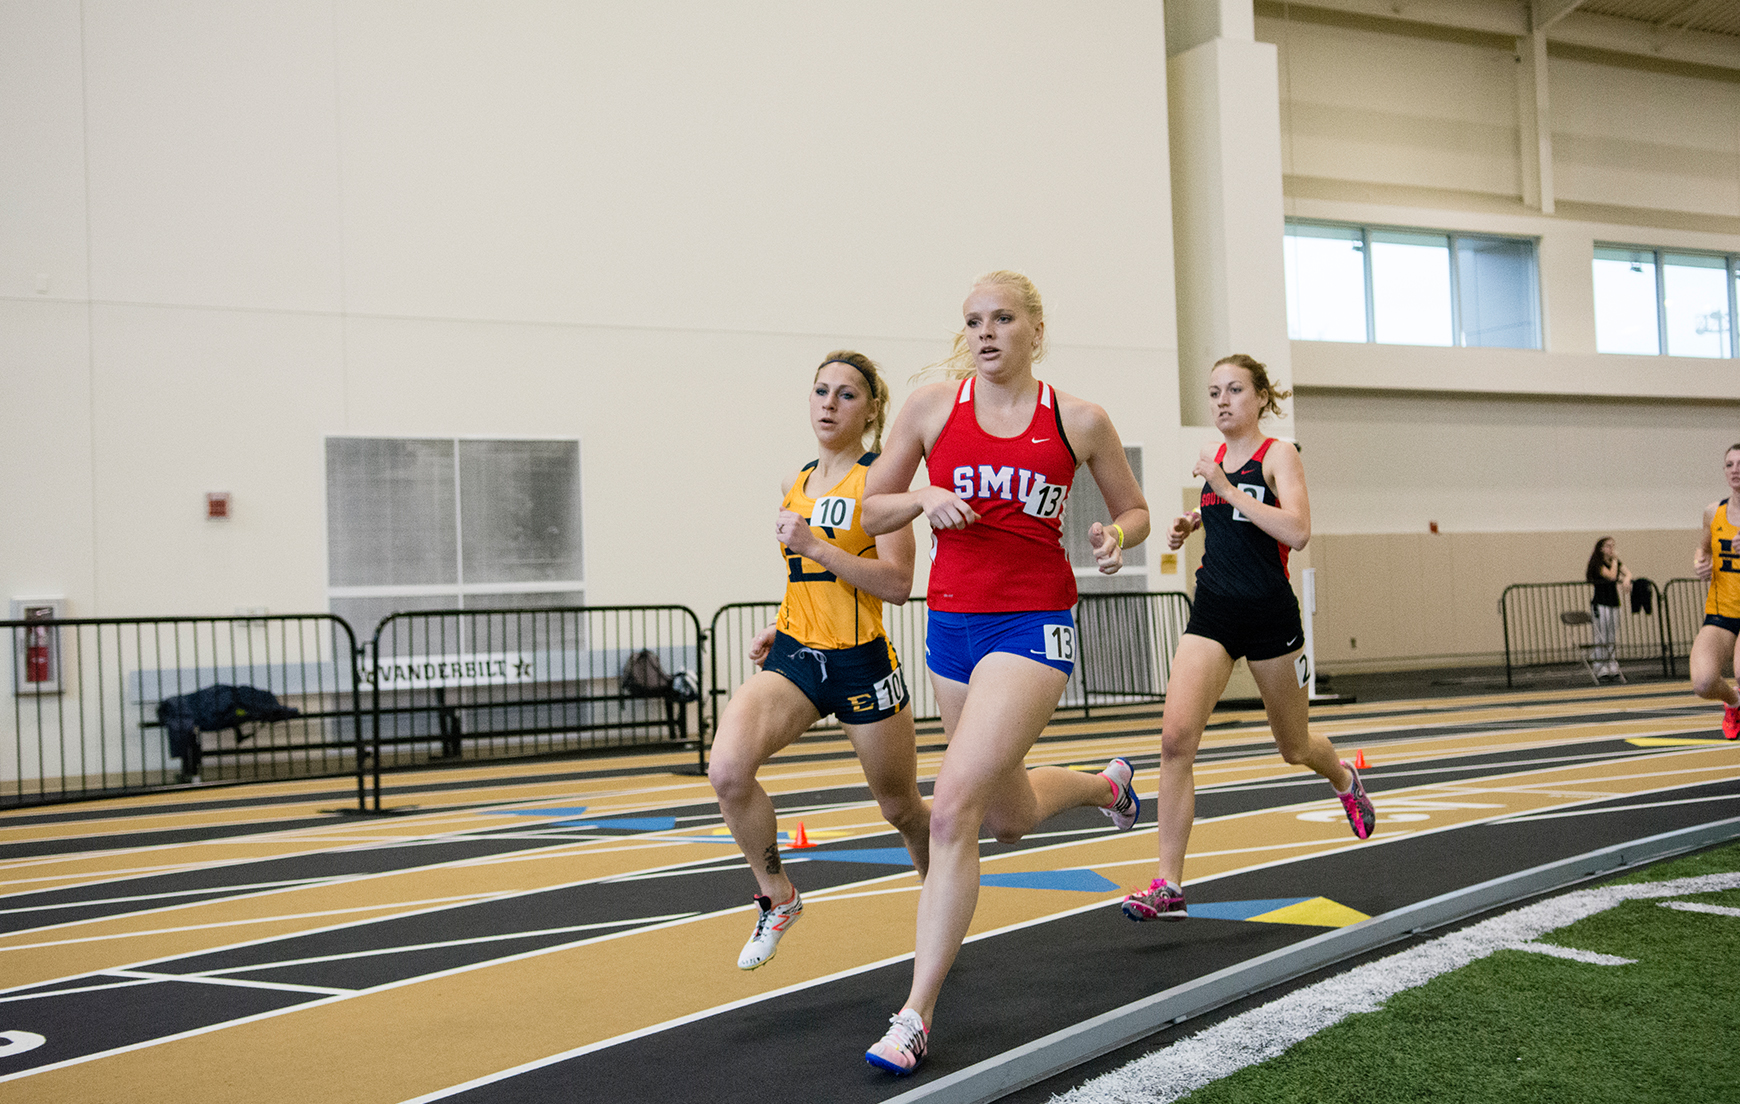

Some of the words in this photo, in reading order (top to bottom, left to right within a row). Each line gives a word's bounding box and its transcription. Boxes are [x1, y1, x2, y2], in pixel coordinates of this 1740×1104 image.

[820, 498, 847, 527] 10
[1036, 485, 1062, 517] 13
[1051, 626, 1074, 660] 13
[377, 659, 508, 683] VANDERBILT
[1298, 654, 1311, 684] 2
[847, 693, 875, 712] E
[881, 672, 902, 706] 10
